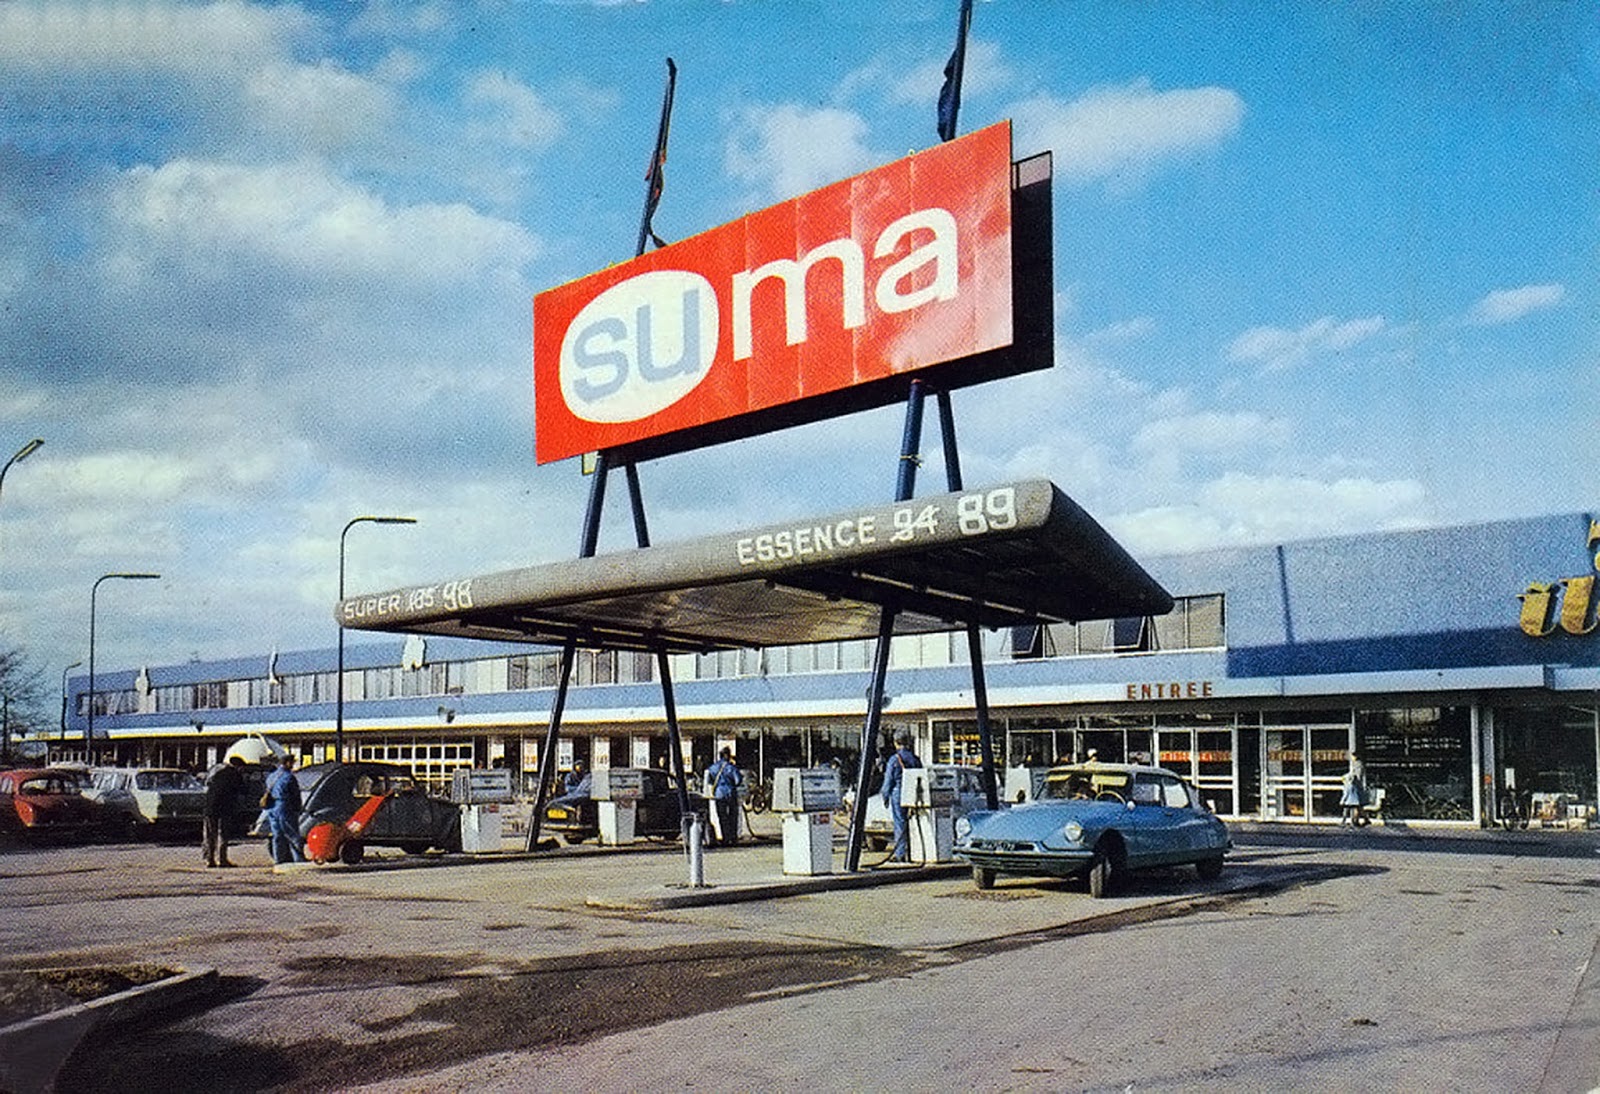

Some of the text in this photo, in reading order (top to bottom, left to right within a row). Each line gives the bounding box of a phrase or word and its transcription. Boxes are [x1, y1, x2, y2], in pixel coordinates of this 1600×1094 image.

[572, 207, 959, 406] suma
[737, 516, 877, 566] ESSENCE
[957, 486, 1018, 536] 89
[343, 594, 401, 619] SUPER
[443, 580, 473, 611] 98
[1126, 681, 1213, 700] ENTREE
